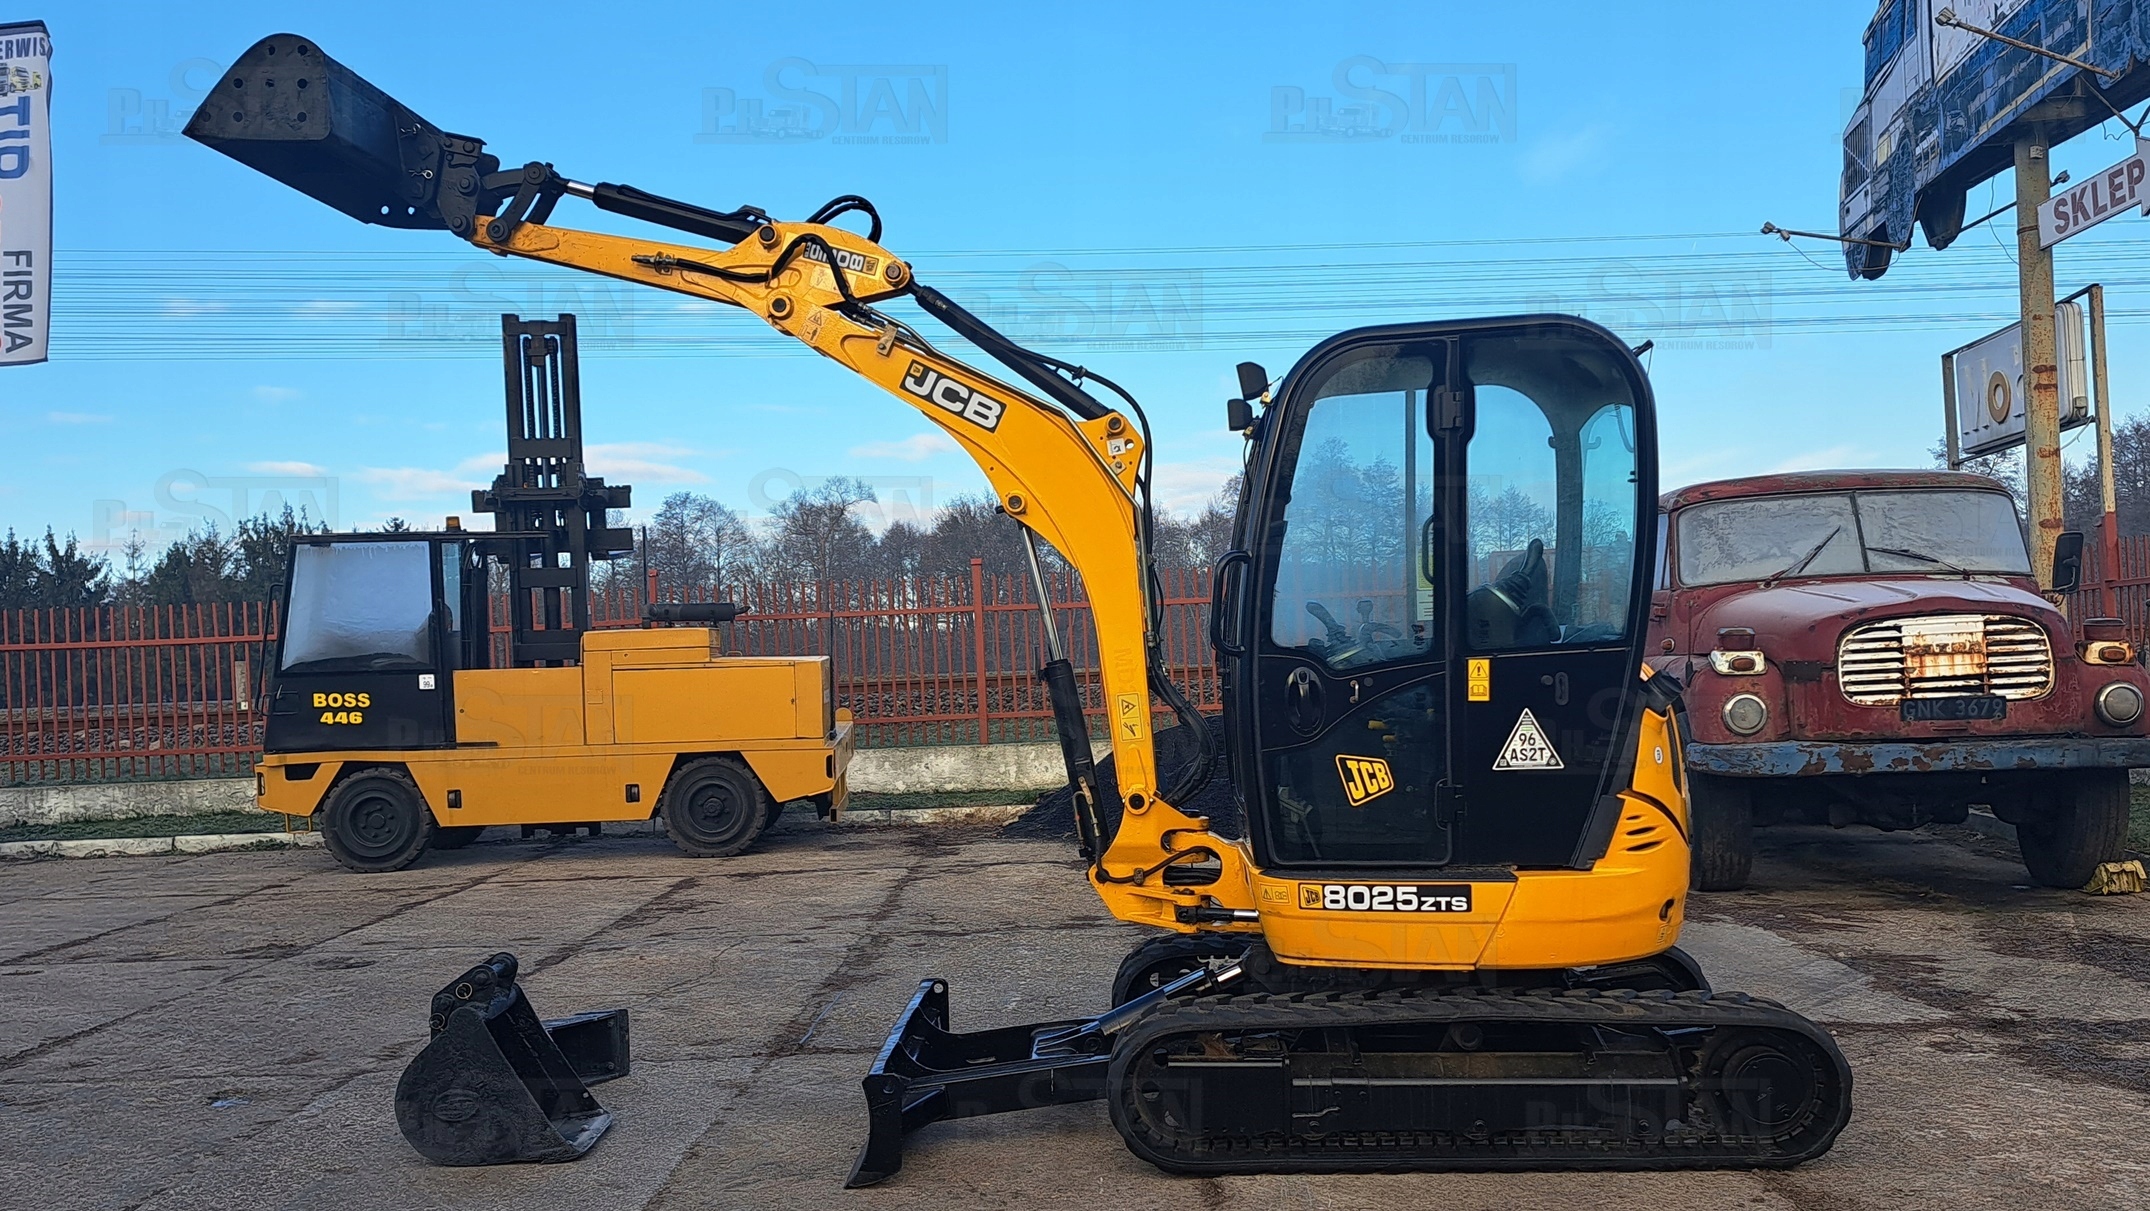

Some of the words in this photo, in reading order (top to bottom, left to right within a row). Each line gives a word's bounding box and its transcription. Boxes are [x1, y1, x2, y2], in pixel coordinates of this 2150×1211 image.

[2054, 159, 2145, 234] SKLEP
[3, 250, 33, 354] FIRMA
[904, 370, 1002, 429] JCB
[313, 692, 371, 708] BOSS
[1903, 700, 1946, 719] GNK
[1955, 698, 2003, 717] 3679
[320, 711, 363, 725] 446
[1518, 732, 1536, 747] 96
[1510, 747, 1546, 762] AS2T
[1345, 759, 1390, 800] JCB
